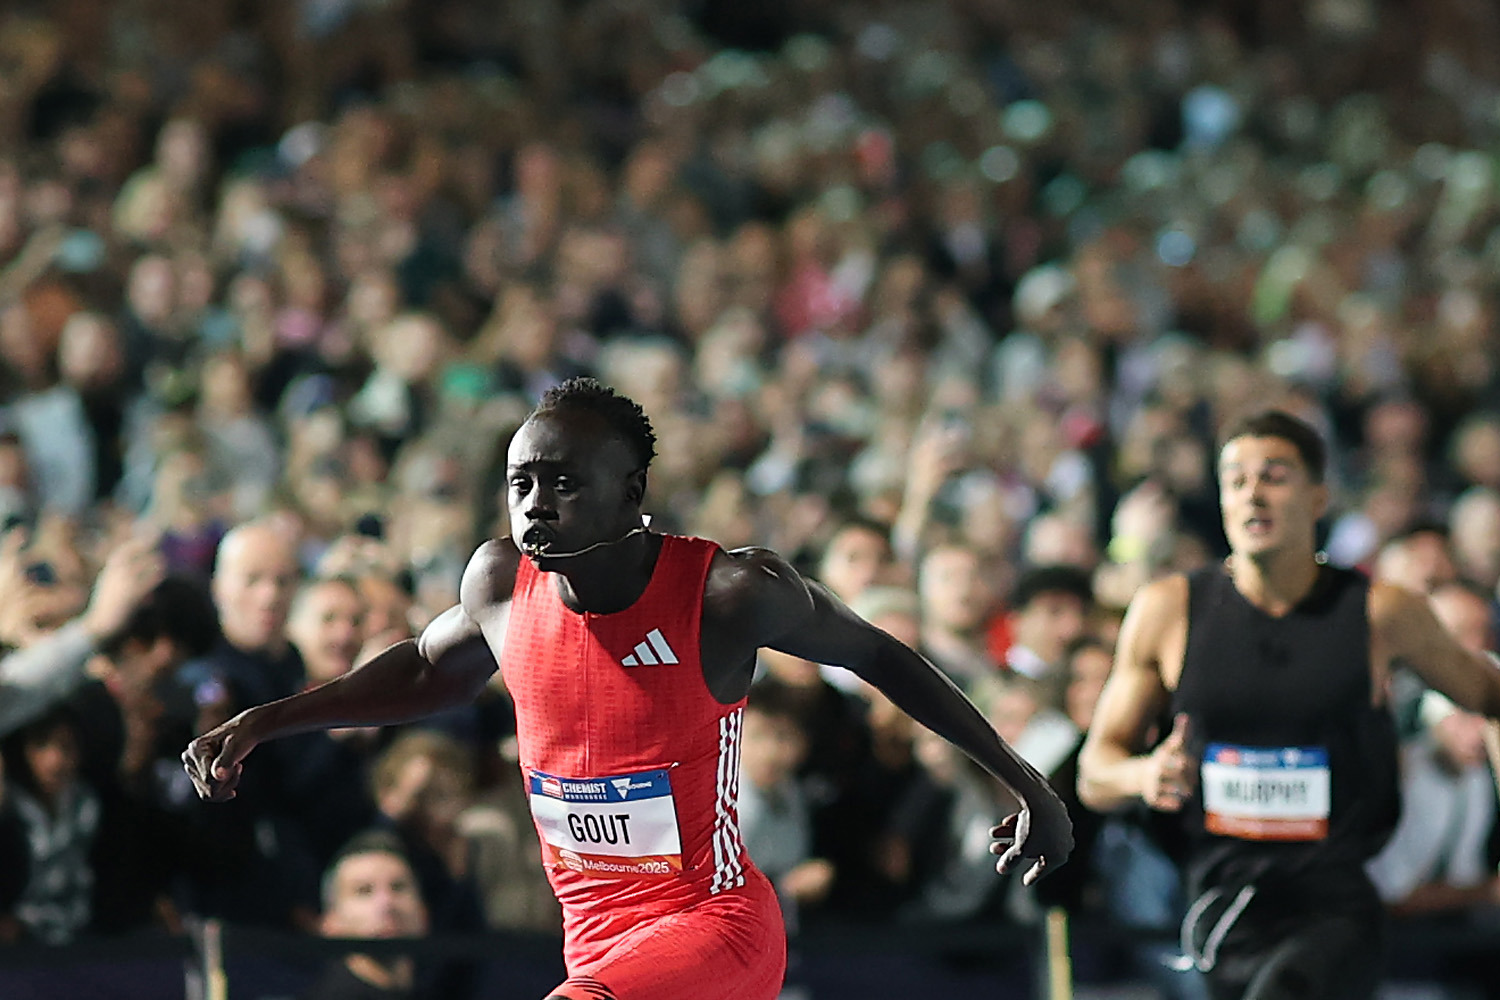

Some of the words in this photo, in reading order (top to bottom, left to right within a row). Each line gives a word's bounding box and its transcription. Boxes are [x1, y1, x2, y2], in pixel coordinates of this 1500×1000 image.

[562, 782, 606, 794] CHEMIST
[568, 813, 630, 845] GOUT
[583, 859, 670, 874] Melbourne2025
